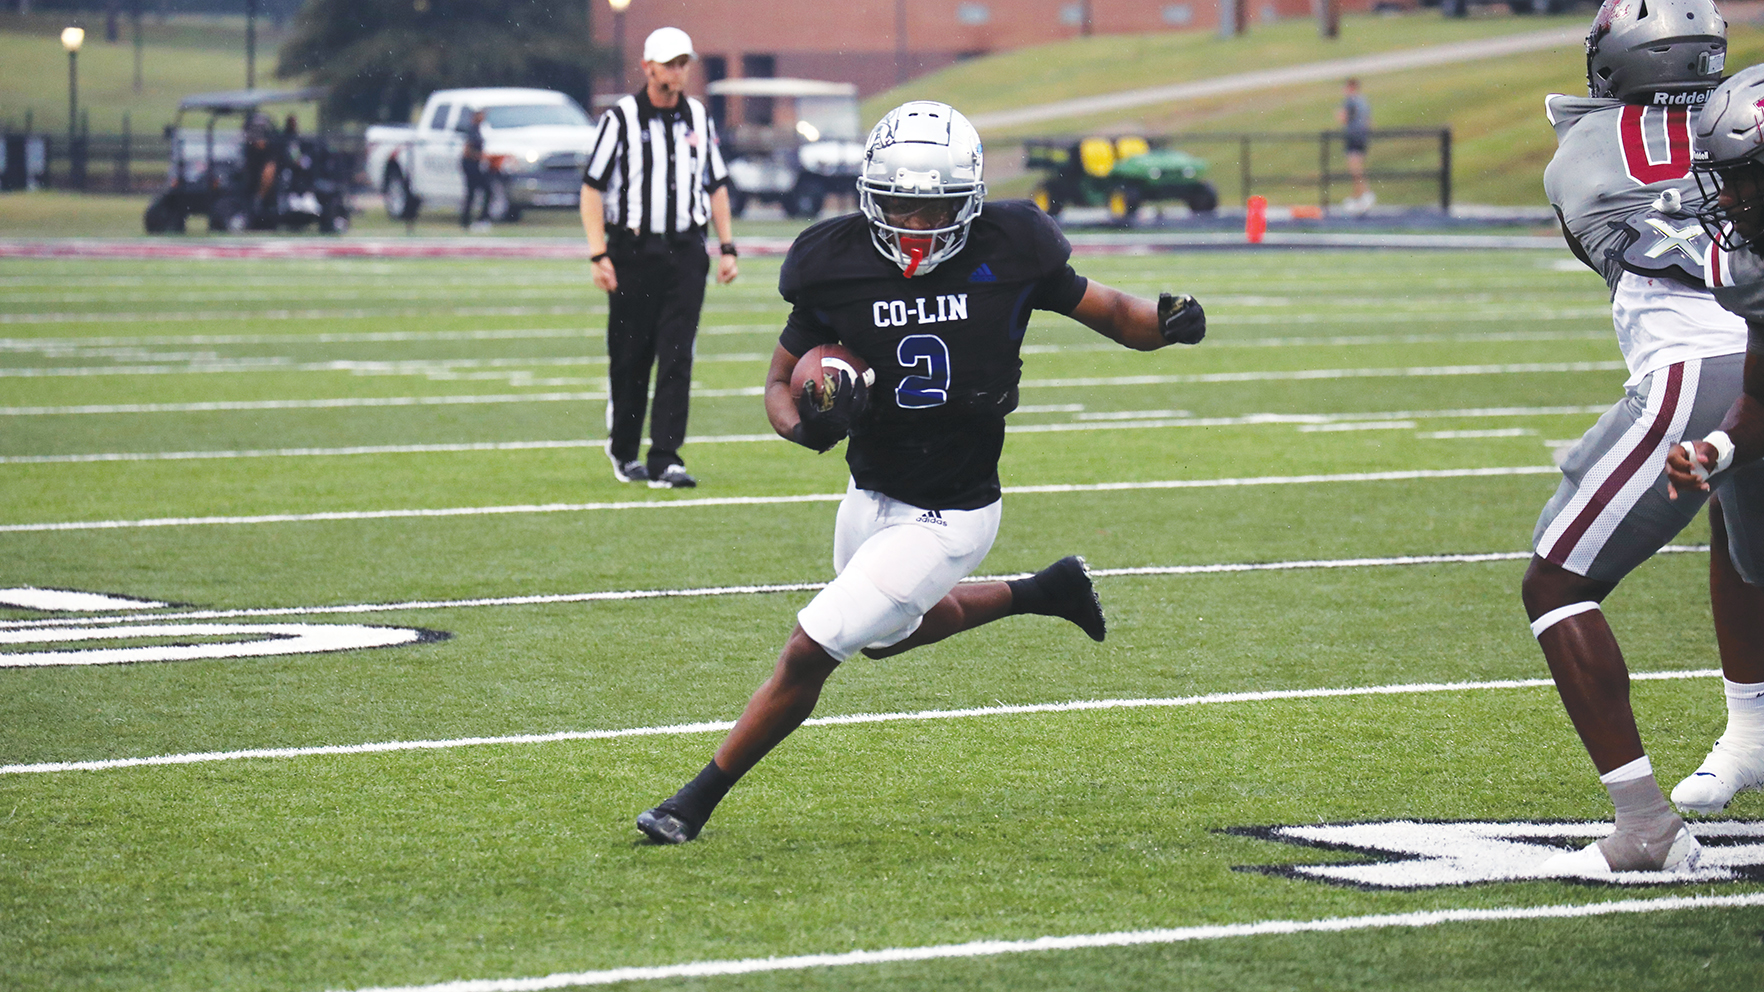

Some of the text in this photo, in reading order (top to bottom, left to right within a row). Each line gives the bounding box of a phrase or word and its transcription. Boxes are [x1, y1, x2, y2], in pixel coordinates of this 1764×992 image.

[1653, 88, 1714, 105] Riddell
[873, 293, 968, 328] CO-LIN
[895, 334, 951, 410] 2
[916, 516, 948, 527] adidas
